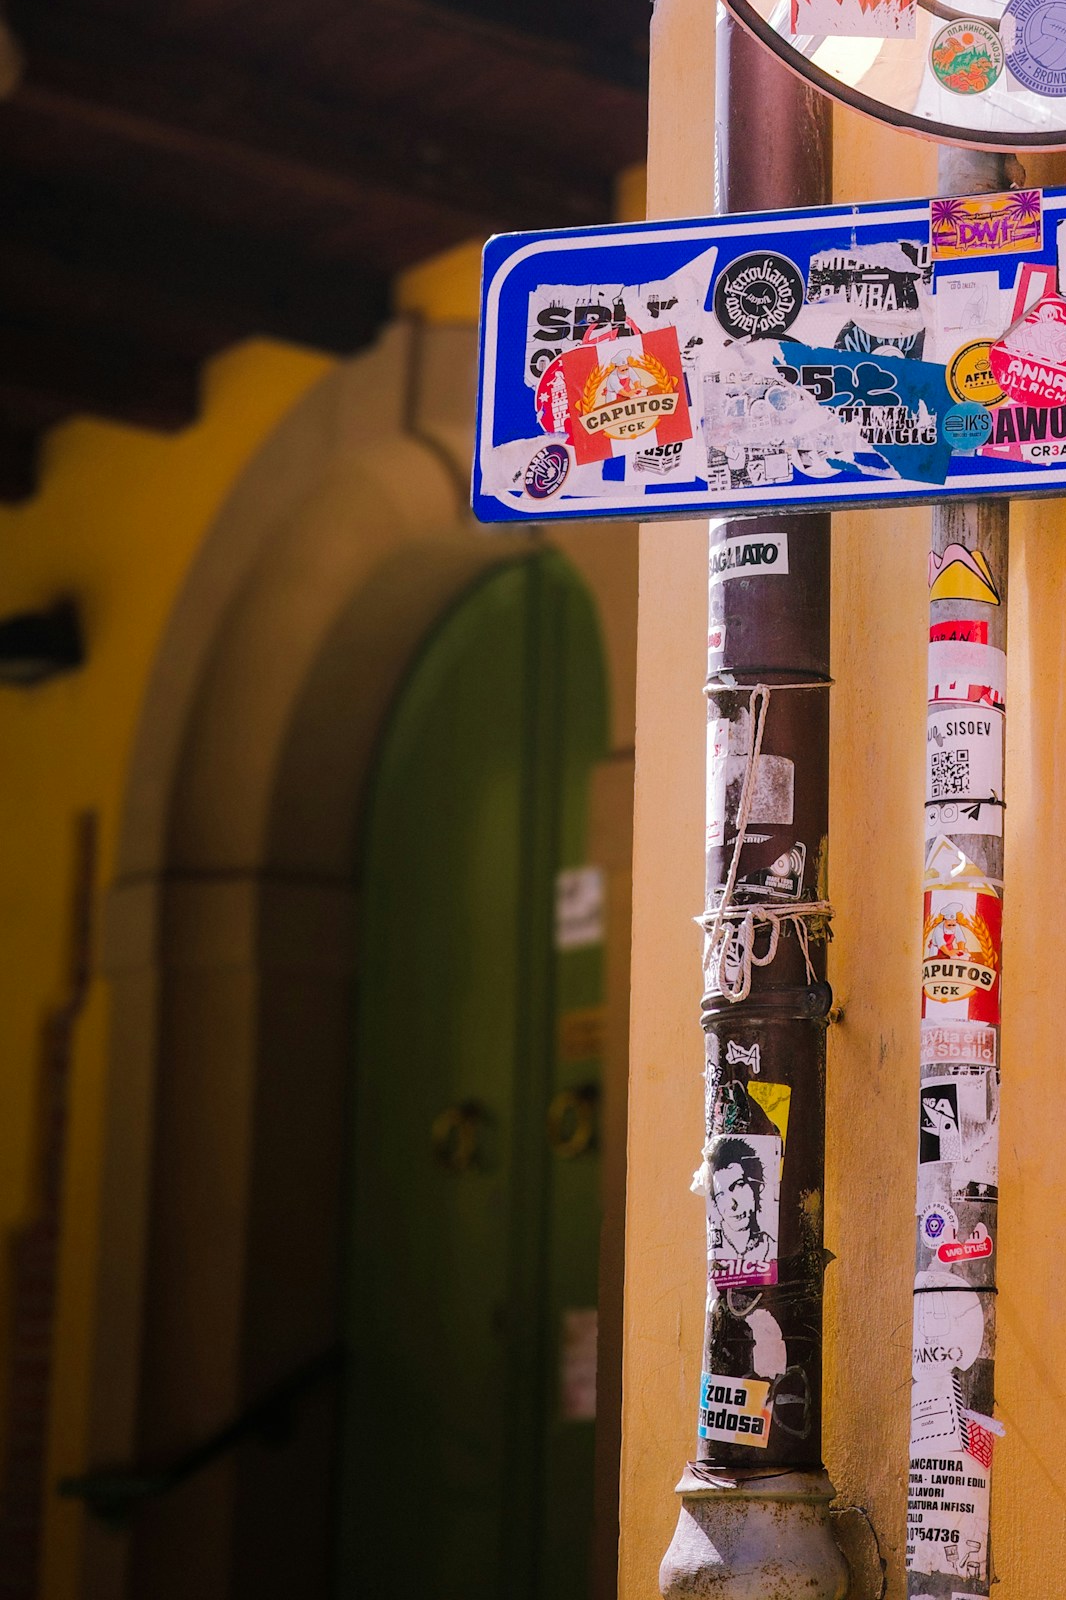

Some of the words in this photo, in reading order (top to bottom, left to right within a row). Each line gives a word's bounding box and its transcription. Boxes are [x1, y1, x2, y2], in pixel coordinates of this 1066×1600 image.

[1015, 50, 1029, 66] WE
[1001, 374, 1066, 402] ULLRICH
[586, 398, 674, 430] CAPUTOS
[619, 421, 646, 435] FCK
[946, 721, 991, 736] SISOEV
[933, 986, 960, 996] FCK
[936, 1043, 992, 1059] Sballo
[945, 1248, 963, 1257] we
[963, 1242, 988, 1254] trust
[931, 1474, 965, 1486] LAVORI
[967, 1477, 986, 1489] EDILI
[915, 1487, 944, 1498] LAVORI
[940, 1502, 975, 1514] INFISSI
